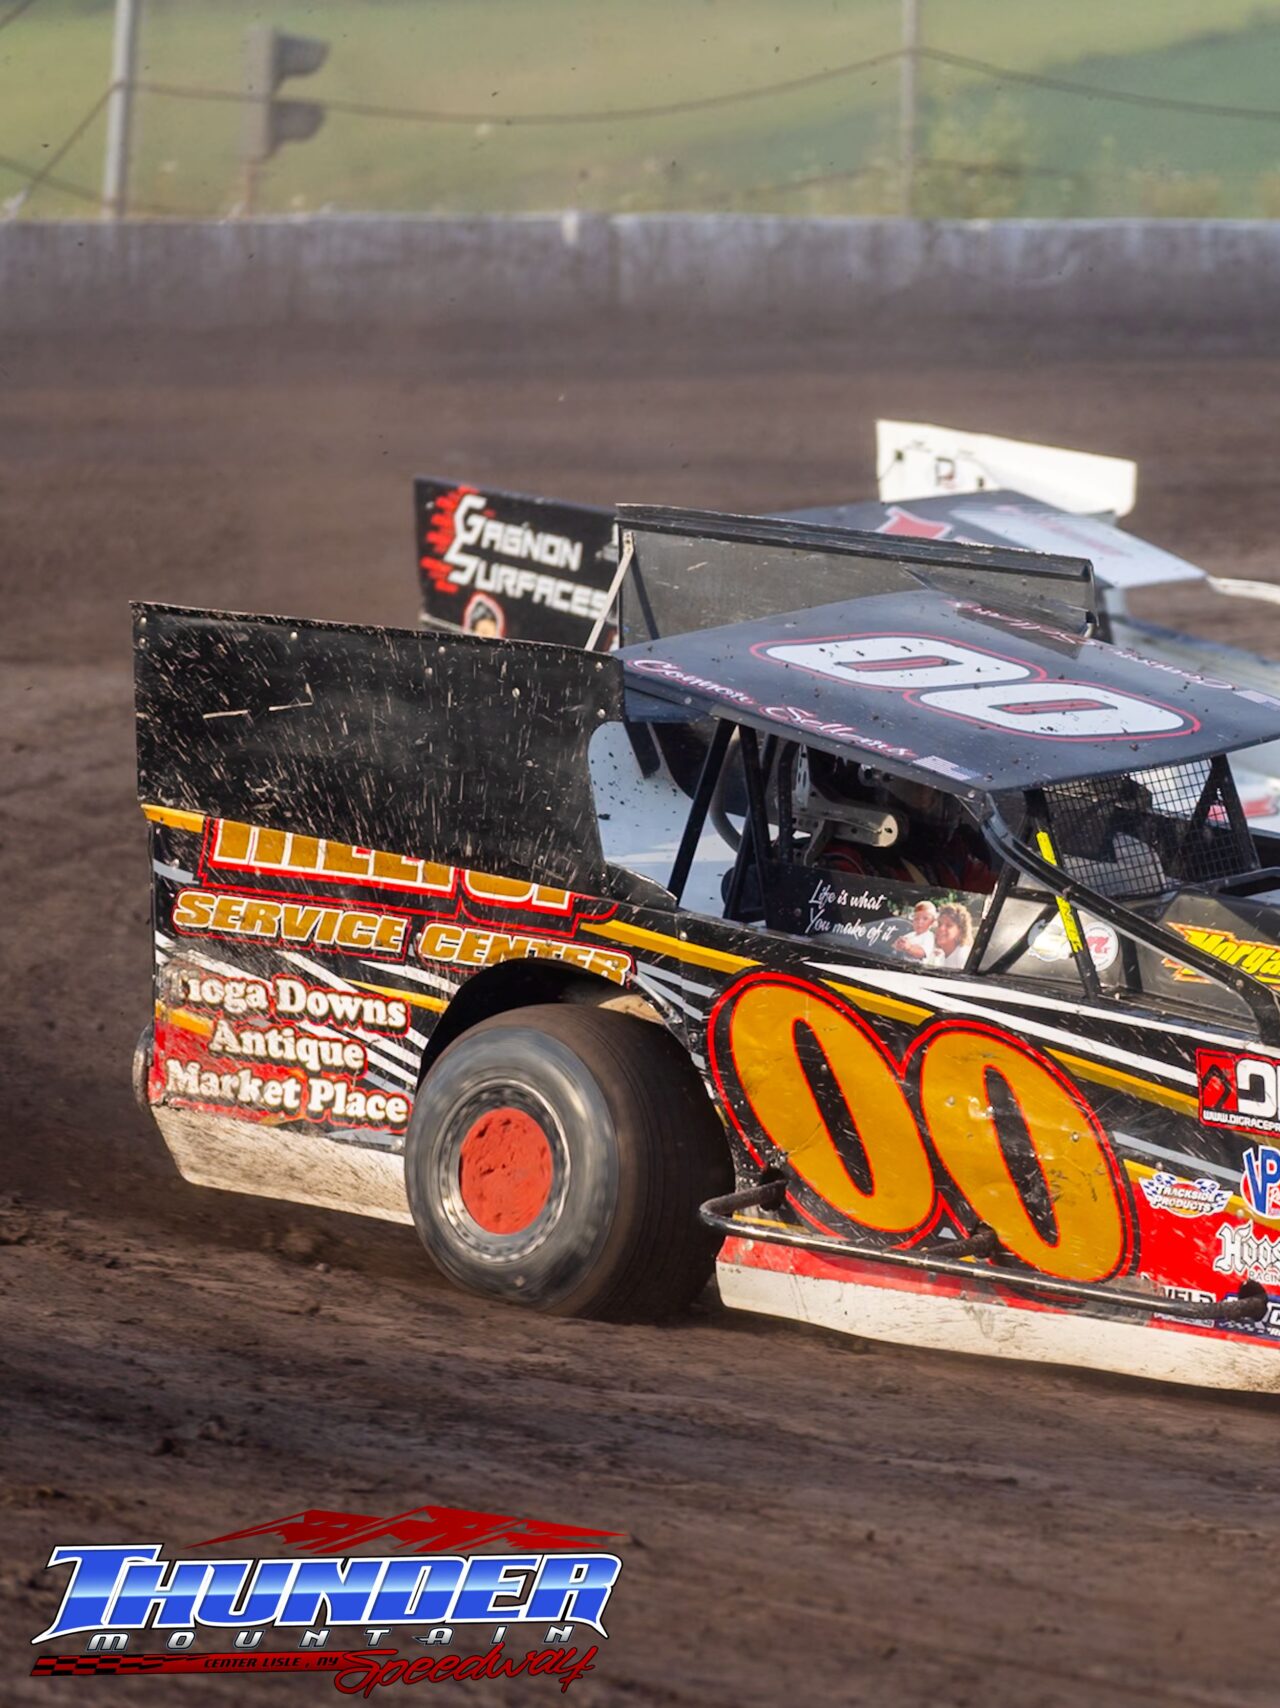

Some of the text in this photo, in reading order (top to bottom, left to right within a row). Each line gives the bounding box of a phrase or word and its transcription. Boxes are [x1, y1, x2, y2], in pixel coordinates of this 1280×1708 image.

[454, 494, 583, 572] GAGNON
[444, 541, 609, 620] SURFACES
[758, 634, 1192, 738] 00
[173, 891, 408, 954] SERVICE
[805, 907, 899, 947] You make of it
[809, 880, 887, 911] Life is what
[276, 976, 408, 1028] Downs
[208, 1018, 365, 1073] Antique
[165, 1058, 408, 1124] Market Place
[722, 980, 1130, 1283] 00
[1151, 1195, 1213, 1213] PRODUCTS
